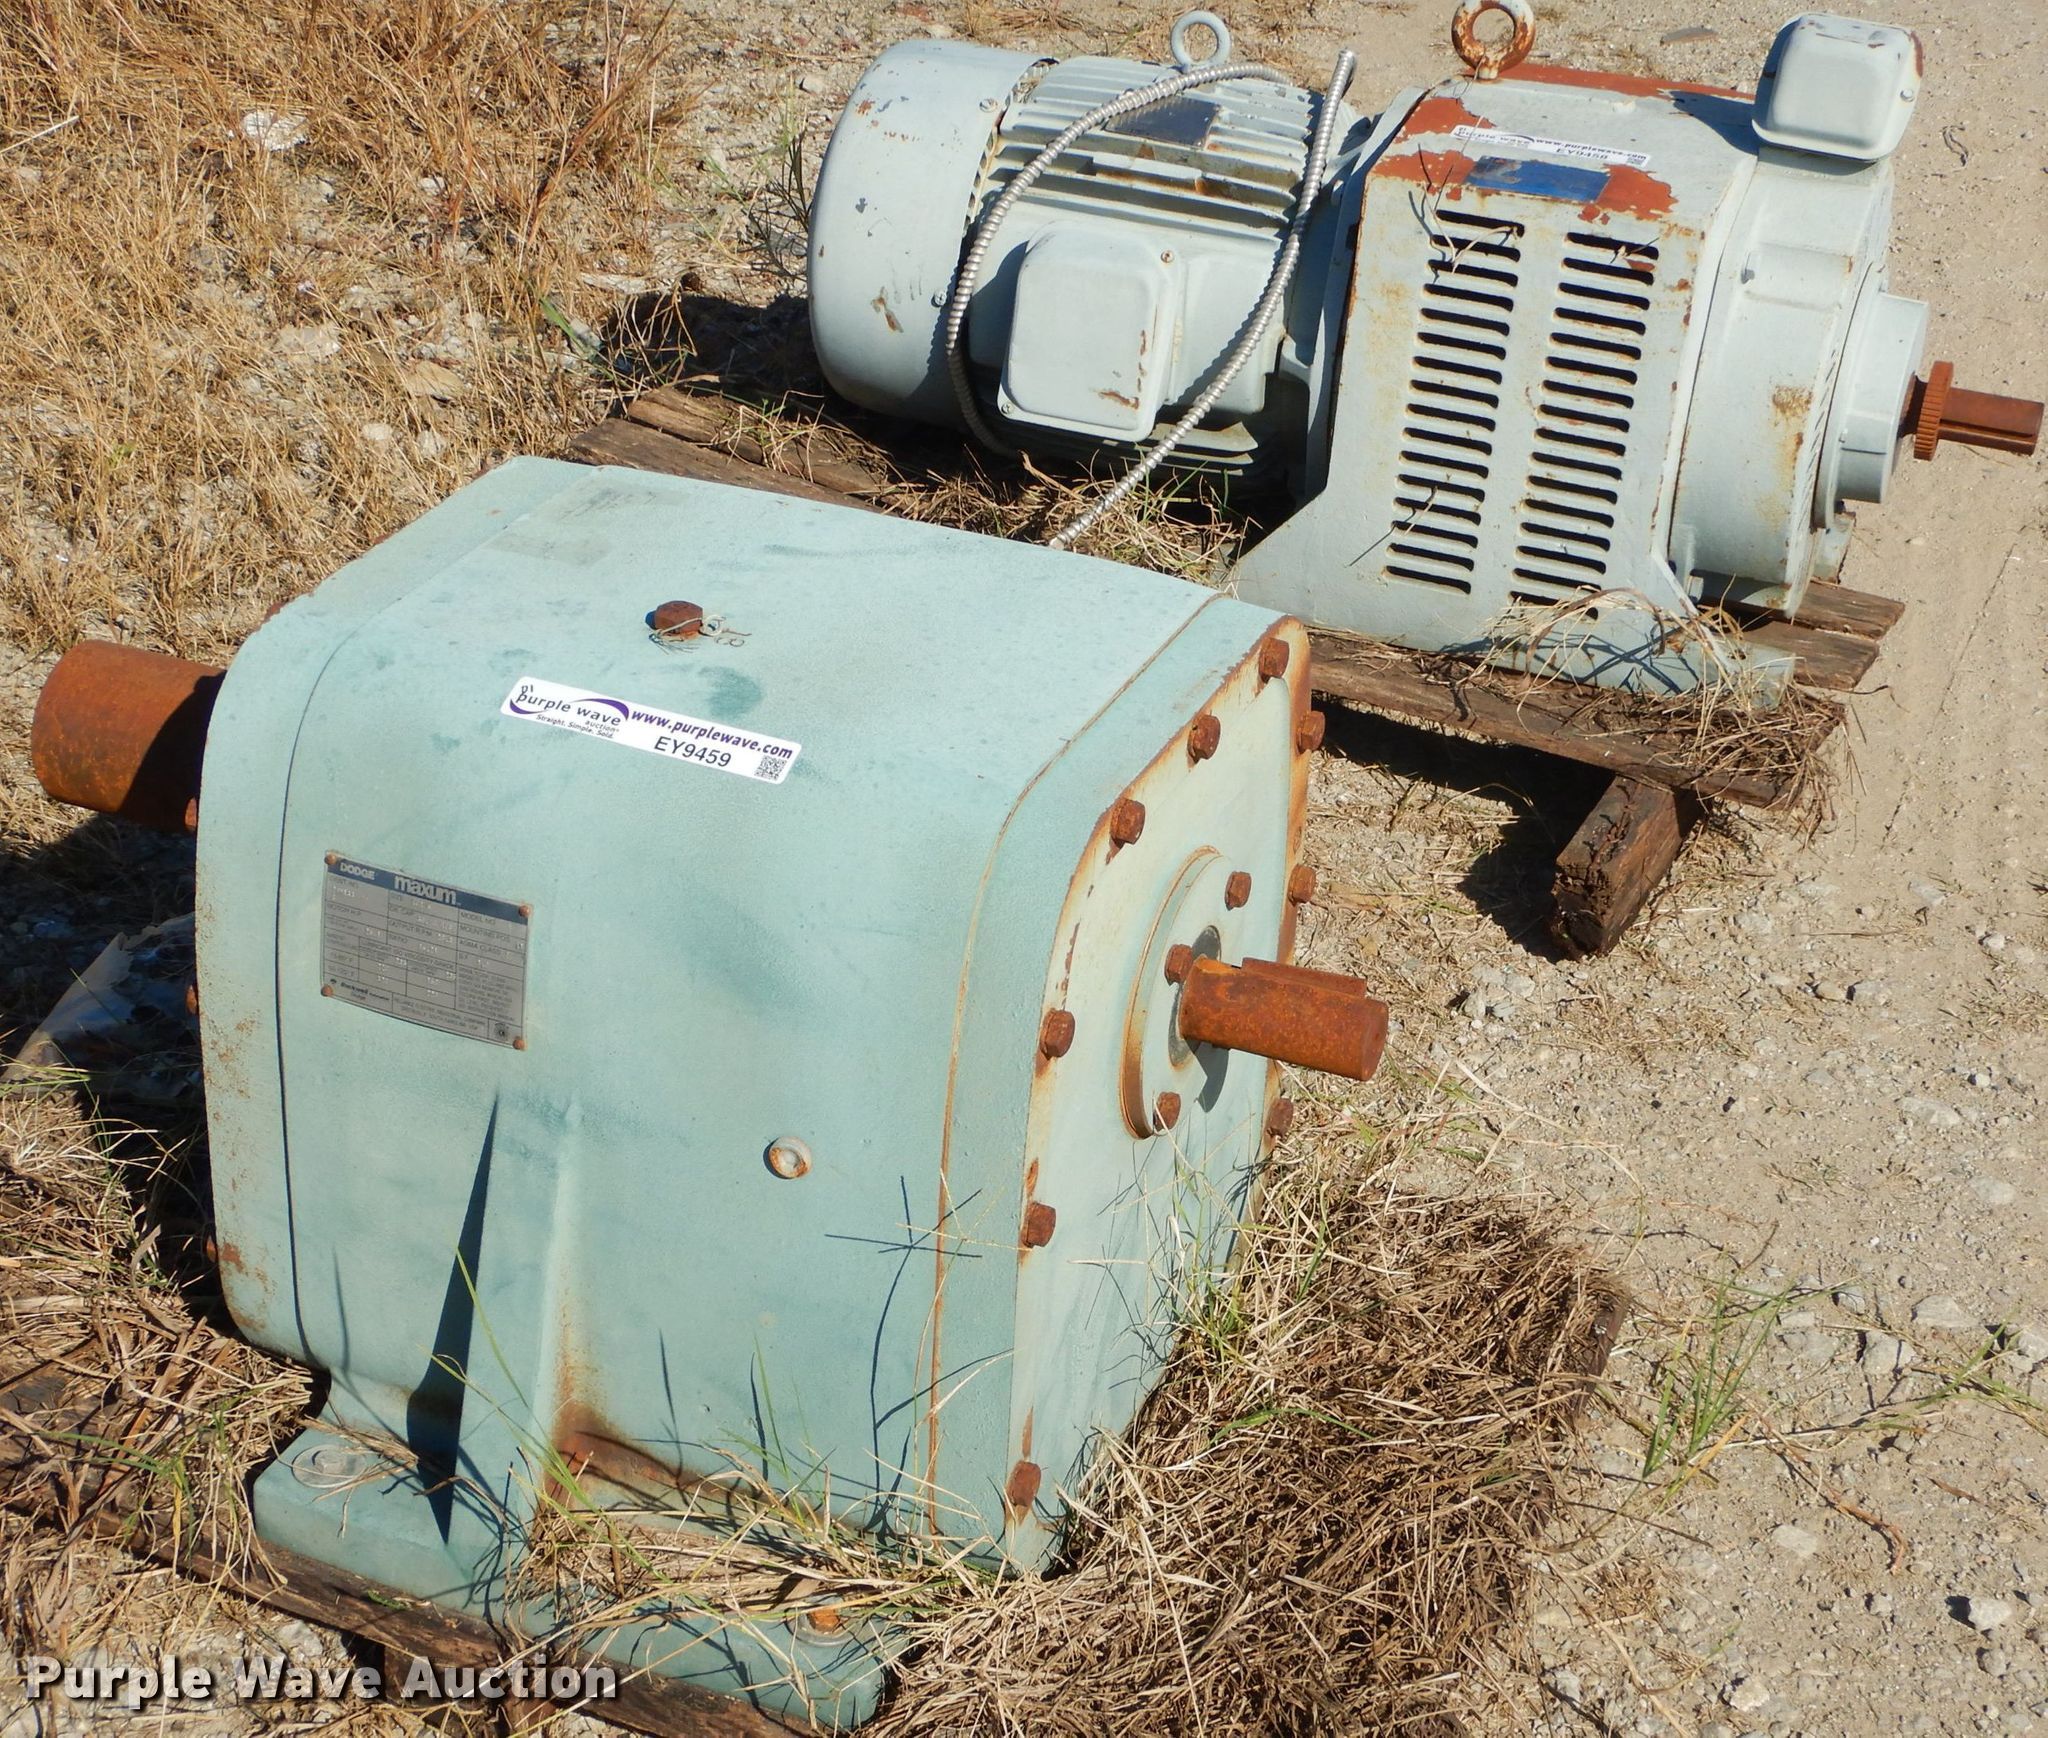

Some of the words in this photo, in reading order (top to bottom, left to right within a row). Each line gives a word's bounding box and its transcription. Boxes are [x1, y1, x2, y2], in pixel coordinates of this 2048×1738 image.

[515, 693, 572, 713] purple
[576, 706, 622, 726] wave
[631, 708, 793, 760] www.purplewave.com
[653, 735, 733, 768] EY9459
[340, 862, 376, 880] DODGE
[394, 875, 458, 905] maxum
